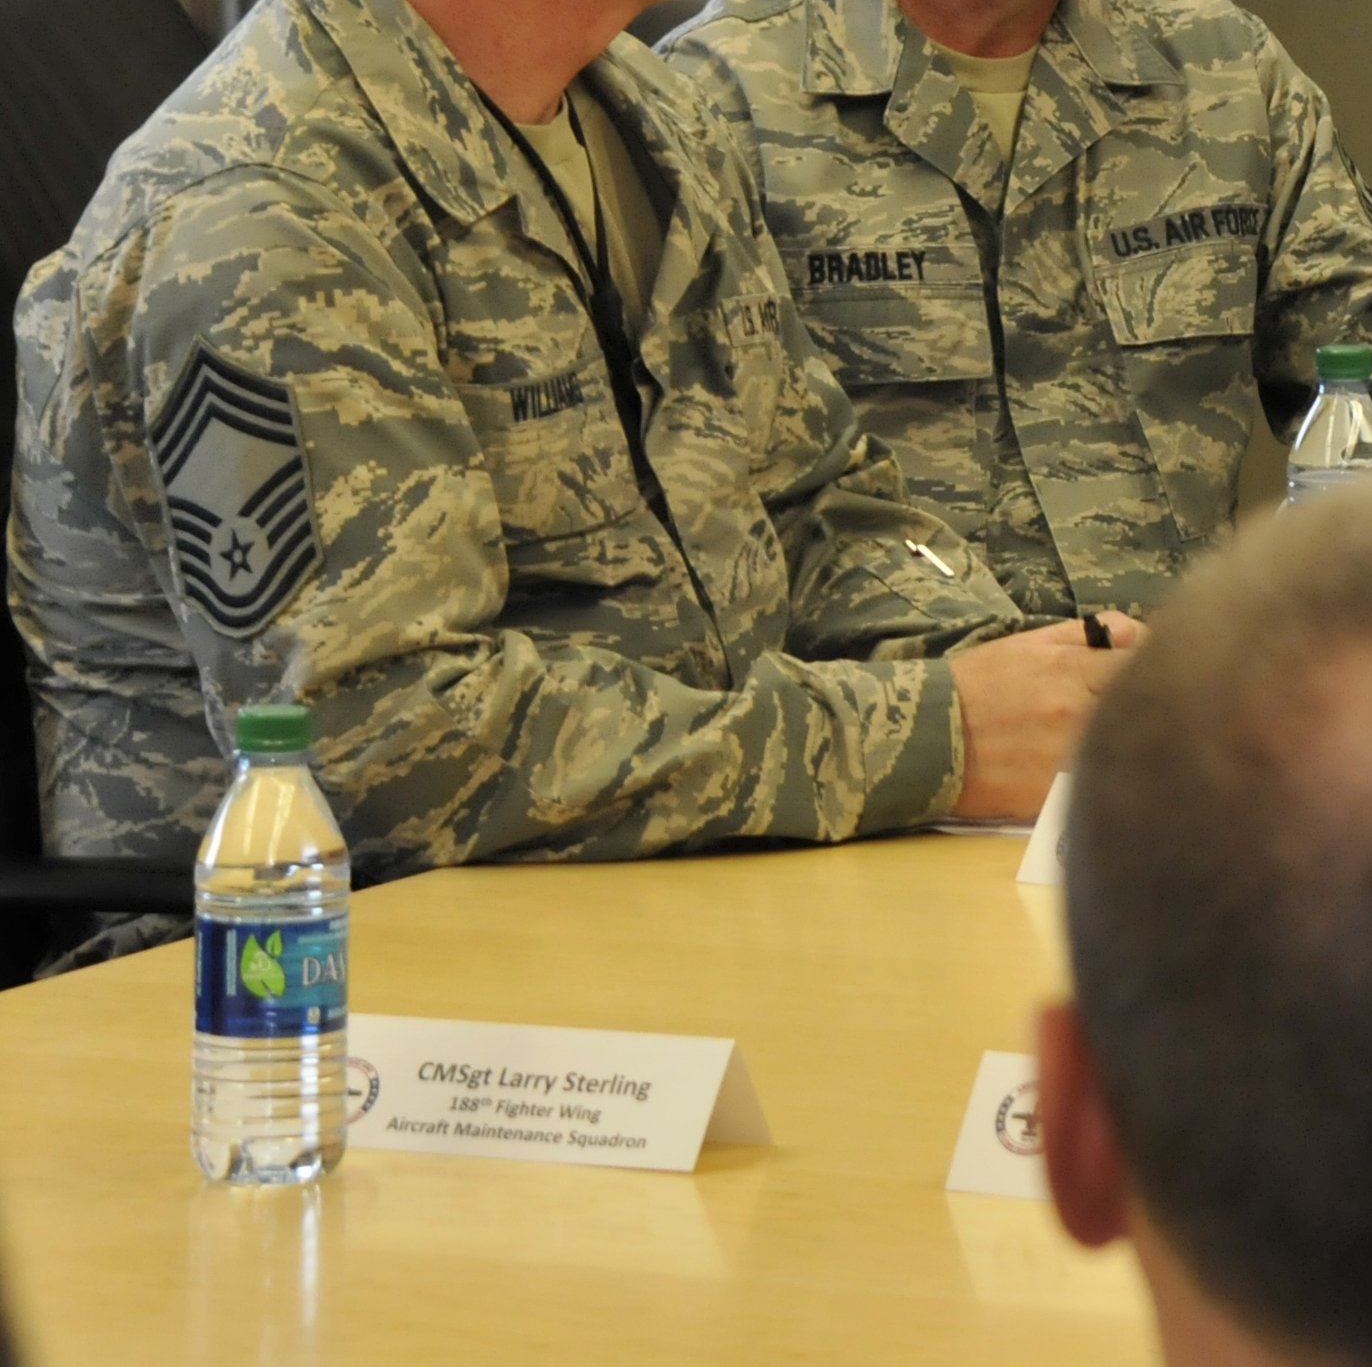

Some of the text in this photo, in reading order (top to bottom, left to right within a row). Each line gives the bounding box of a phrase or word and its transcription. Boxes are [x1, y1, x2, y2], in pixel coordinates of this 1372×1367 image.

[1111, 226, 1160, 258] U.S.
[1165, 210, 1210, 246] AIR
[807, 250, 927, 285] BRADLEY
[418, 1061, 652, 1102] CMSgt Larry Sterling
[449, 1096, 602, 1125] 188th Fighter Wing
[386, 1116, 648, 1149] Aircraft Maintenance Squadron
